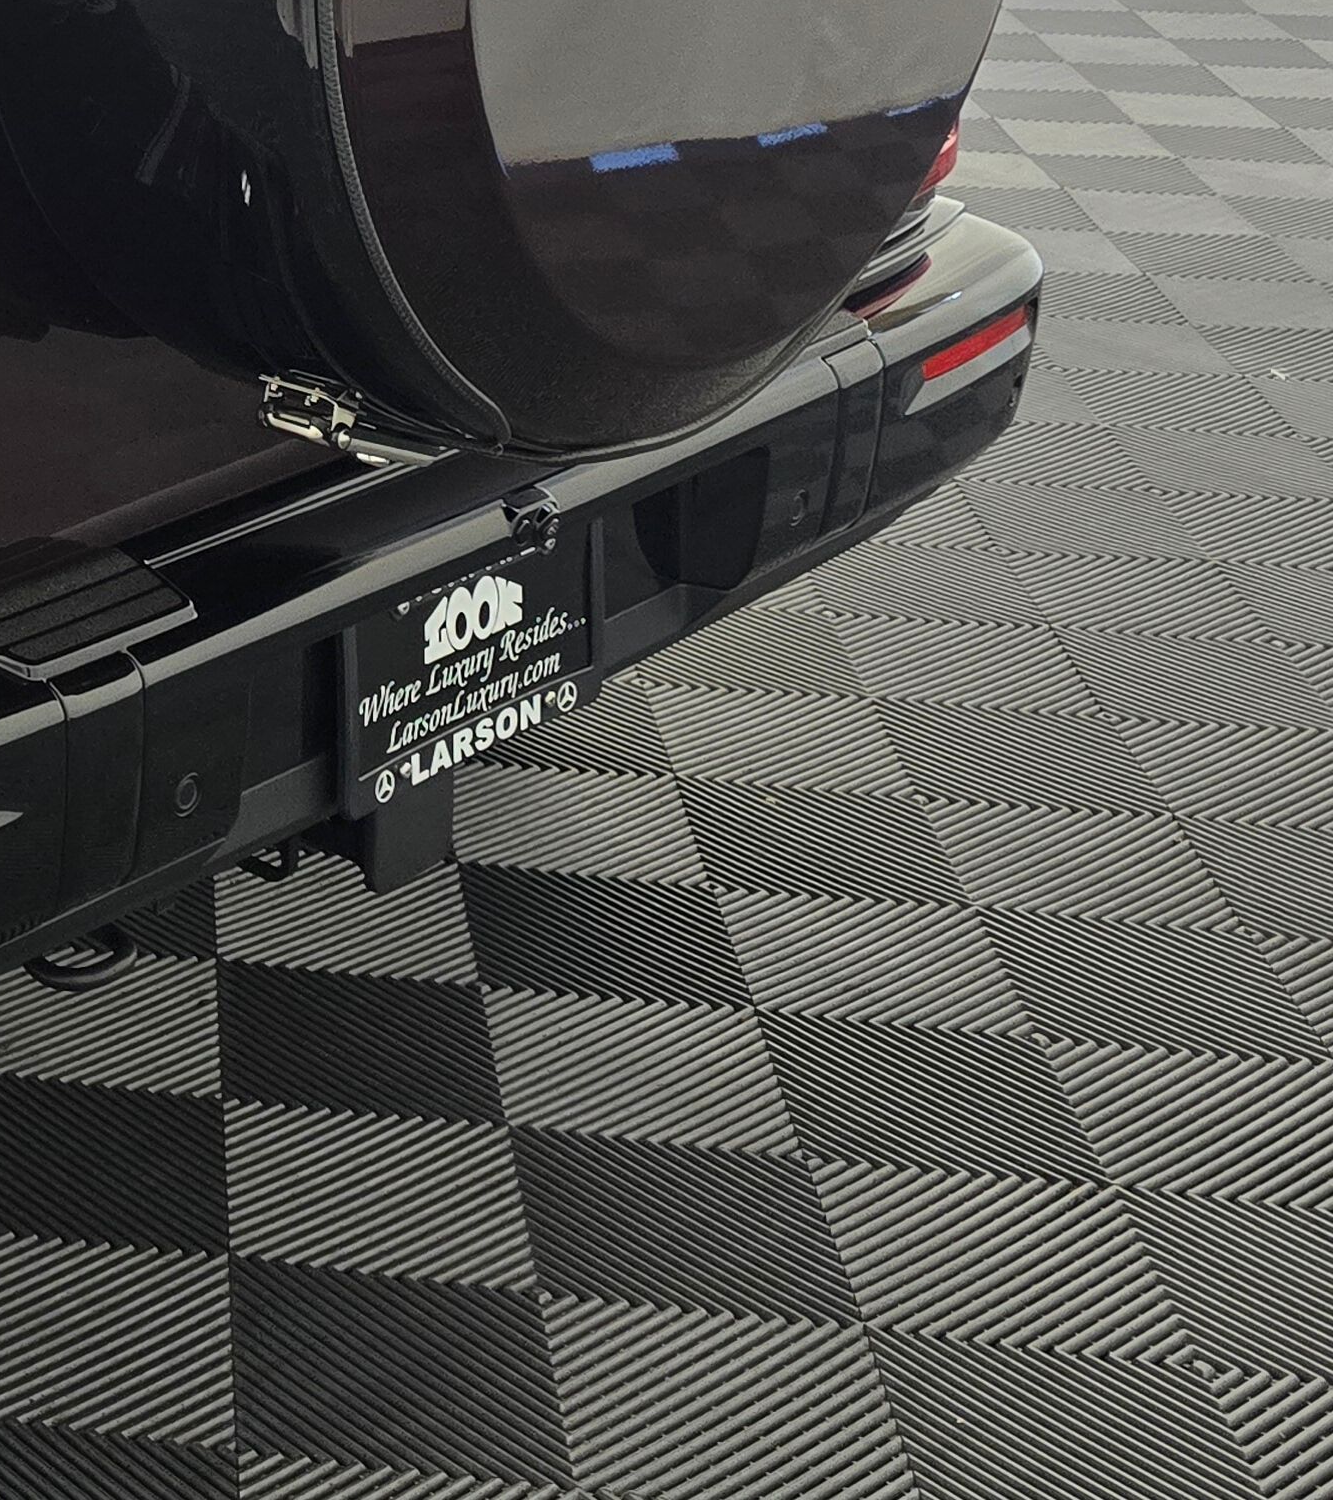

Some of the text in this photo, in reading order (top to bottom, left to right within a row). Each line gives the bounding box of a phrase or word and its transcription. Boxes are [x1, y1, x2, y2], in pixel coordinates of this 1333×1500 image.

[359, 606, 586, 727] Where Luxury Resides...
[386, 652, 561, 754] LarsonLuxury.com
[410, 693, 541, 786] LARSON
